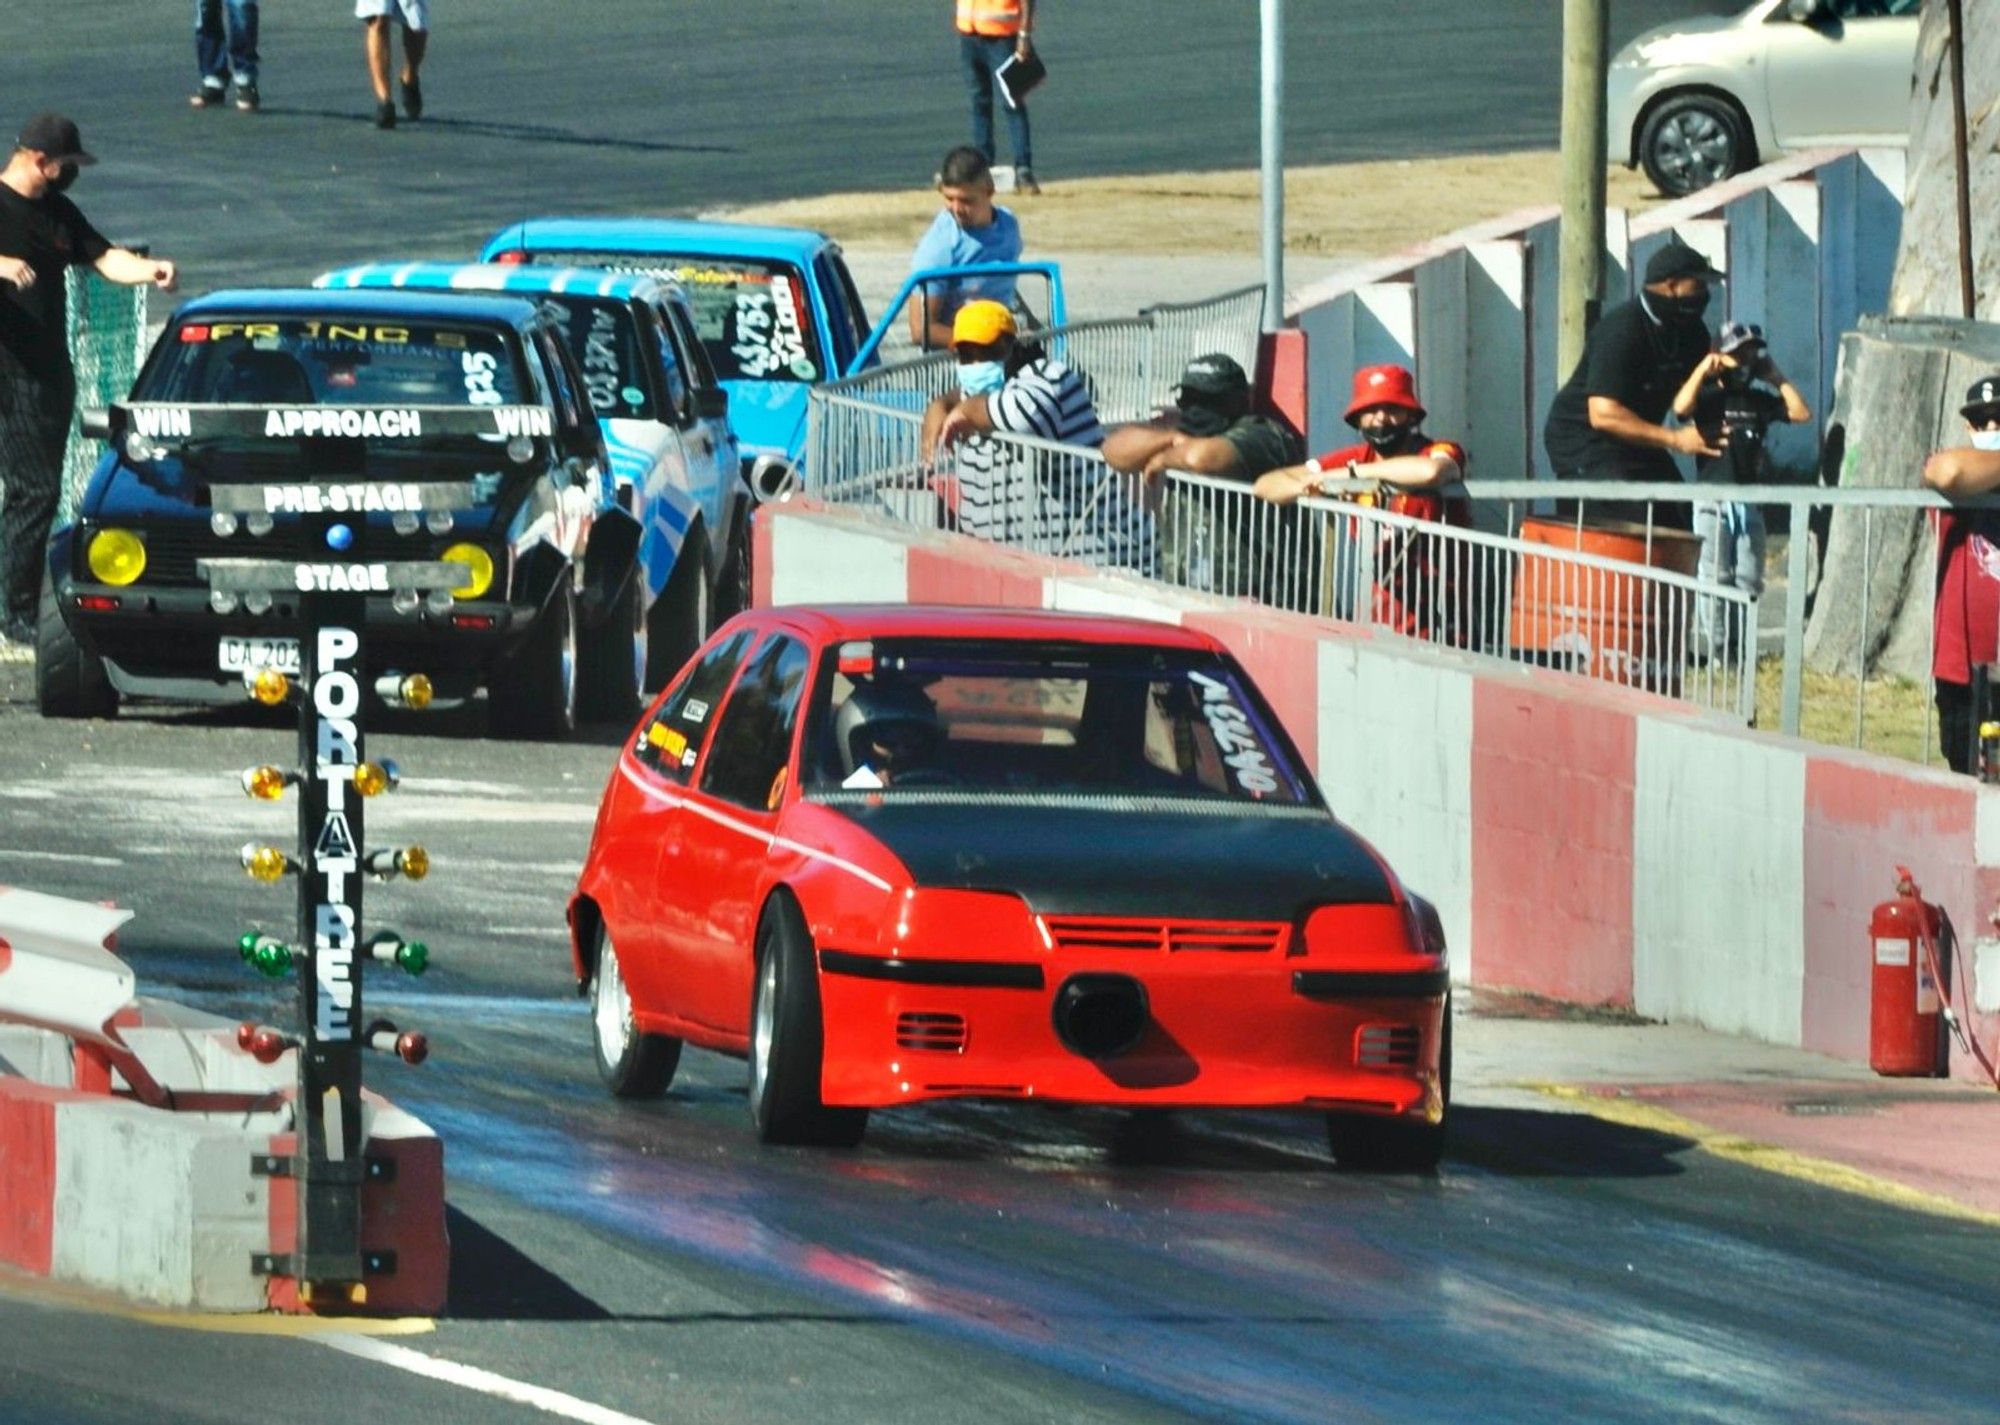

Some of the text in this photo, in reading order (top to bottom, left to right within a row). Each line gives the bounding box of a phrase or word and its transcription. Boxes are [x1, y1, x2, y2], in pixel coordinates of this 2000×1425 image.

[132, 407, 191, 437] WIN
[265, 409, 421, 437] APPROACH
[492, 408, 552, 437] WIN
[263, 484, 422, 513] PRE-STAGE
[294, 563, 389, 592] STAGE
[227, 639, 252, 666] CA
